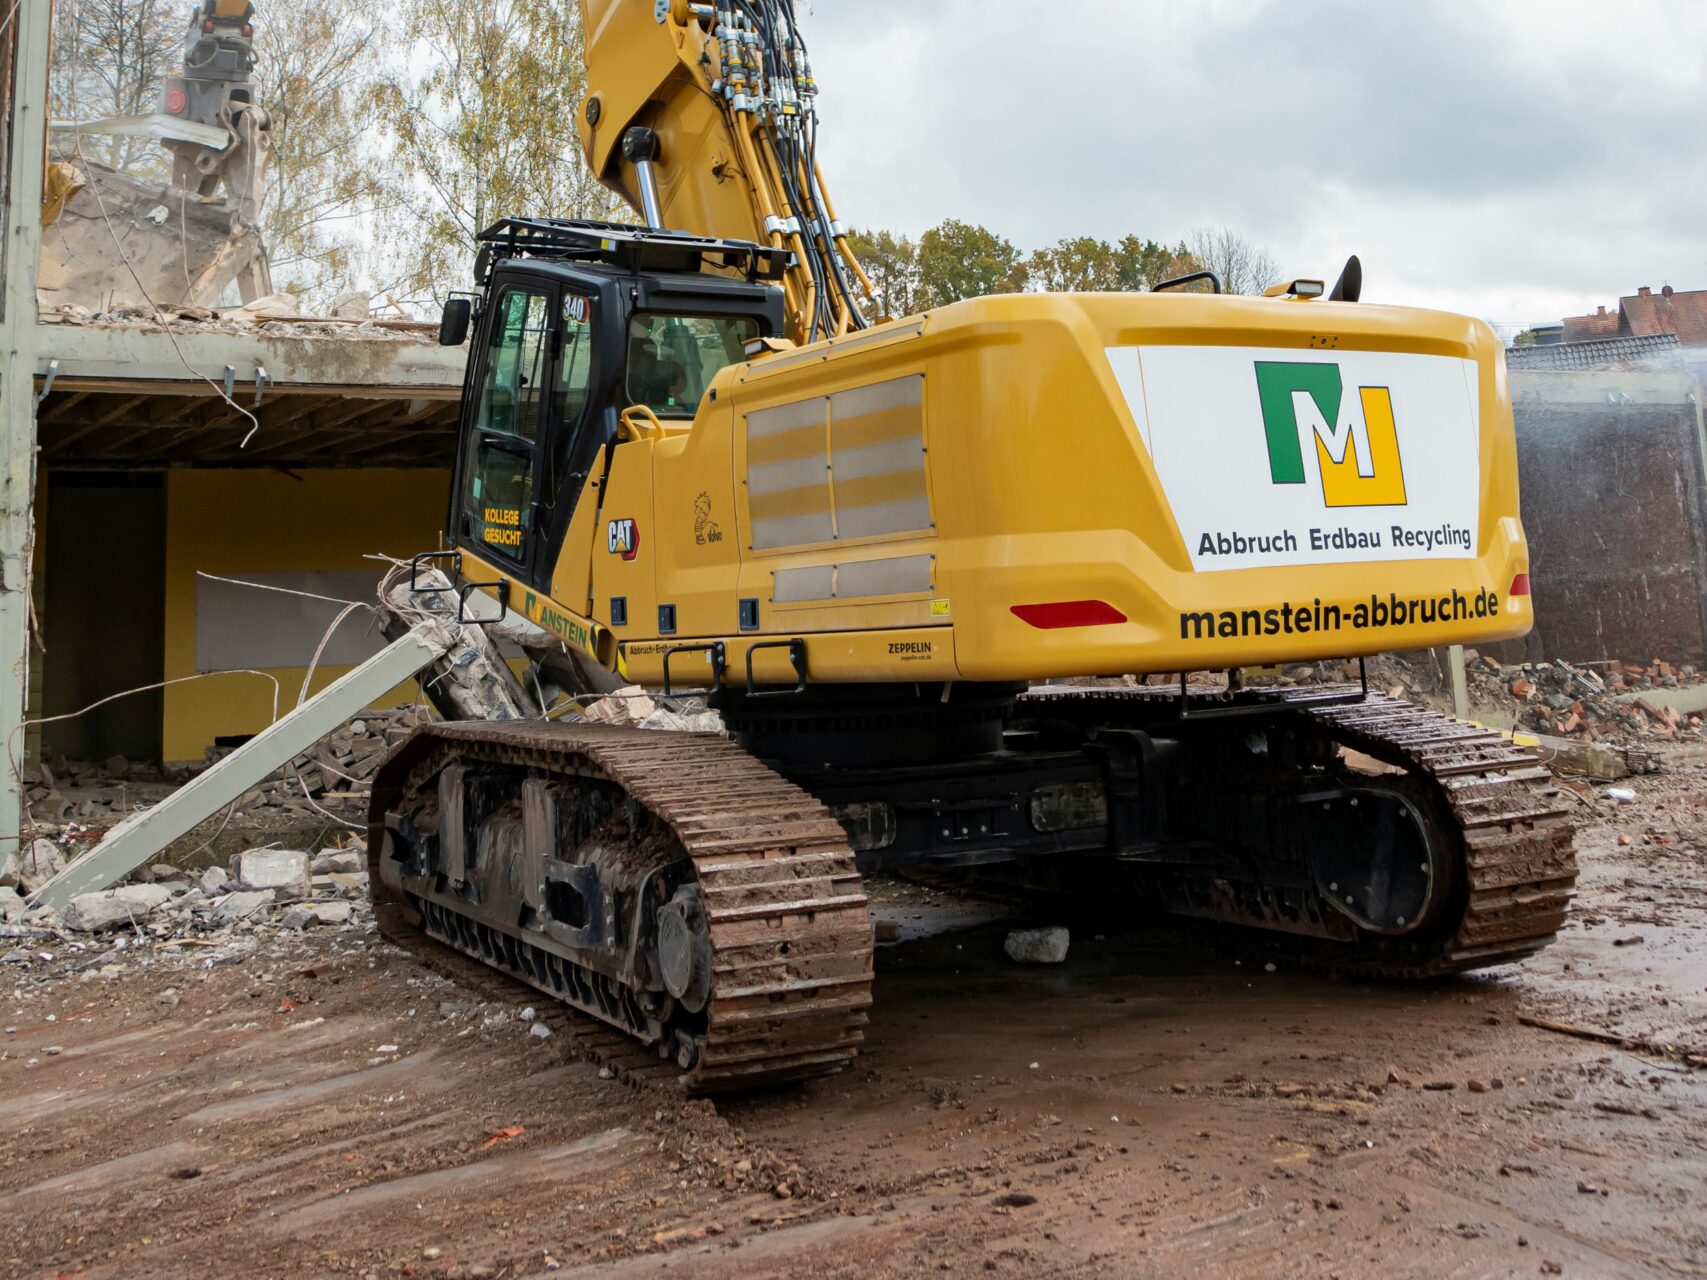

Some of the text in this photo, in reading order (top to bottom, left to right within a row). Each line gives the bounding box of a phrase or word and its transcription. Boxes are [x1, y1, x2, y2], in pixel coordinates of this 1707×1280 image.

[563, 295, 584, 321] 340
[485, 508, 519, 525] KOLLEGE
[485, 528, 521, 545] GESUCHT
[608, 519, 632, 552] CAT
[1198, 524, 1471, 556] Abbruch Erdbau Recycling
[1180, 586, 1498, 639] manstein-abbruch.de
[630, 645, 653, 654] Abbruch
[888, 642, 931, 653] ZEPPELIN
